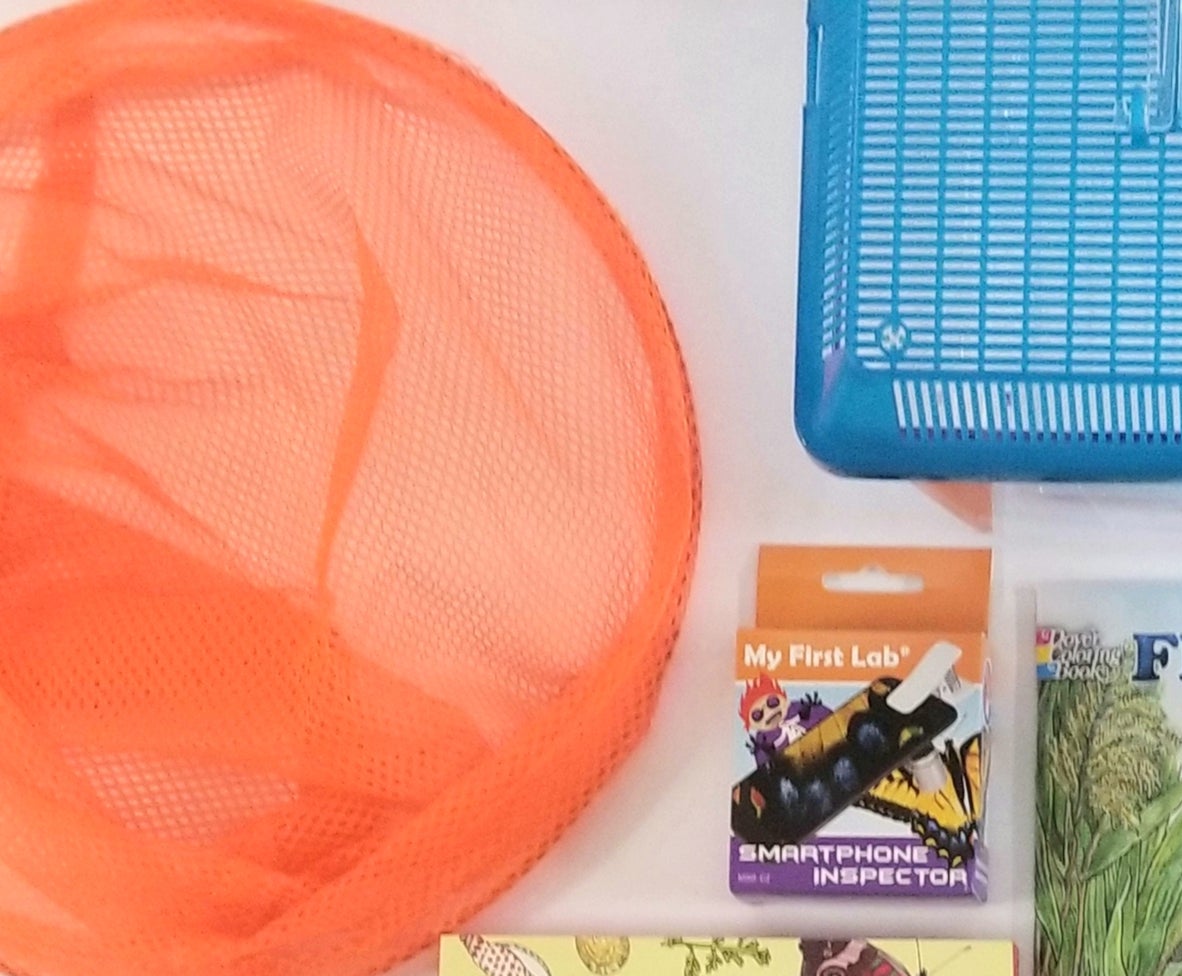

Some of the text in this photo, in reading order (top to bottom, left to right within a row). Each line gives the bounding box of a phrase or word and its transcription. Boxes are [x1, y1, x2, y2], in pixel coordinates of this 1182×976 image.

[744, 644, 781, 670] My
[789, 644, 845, 668] First
[738, 844, 930, 865] SMARTPHONE
[813, 867, 969, 888] INSPECTOR
